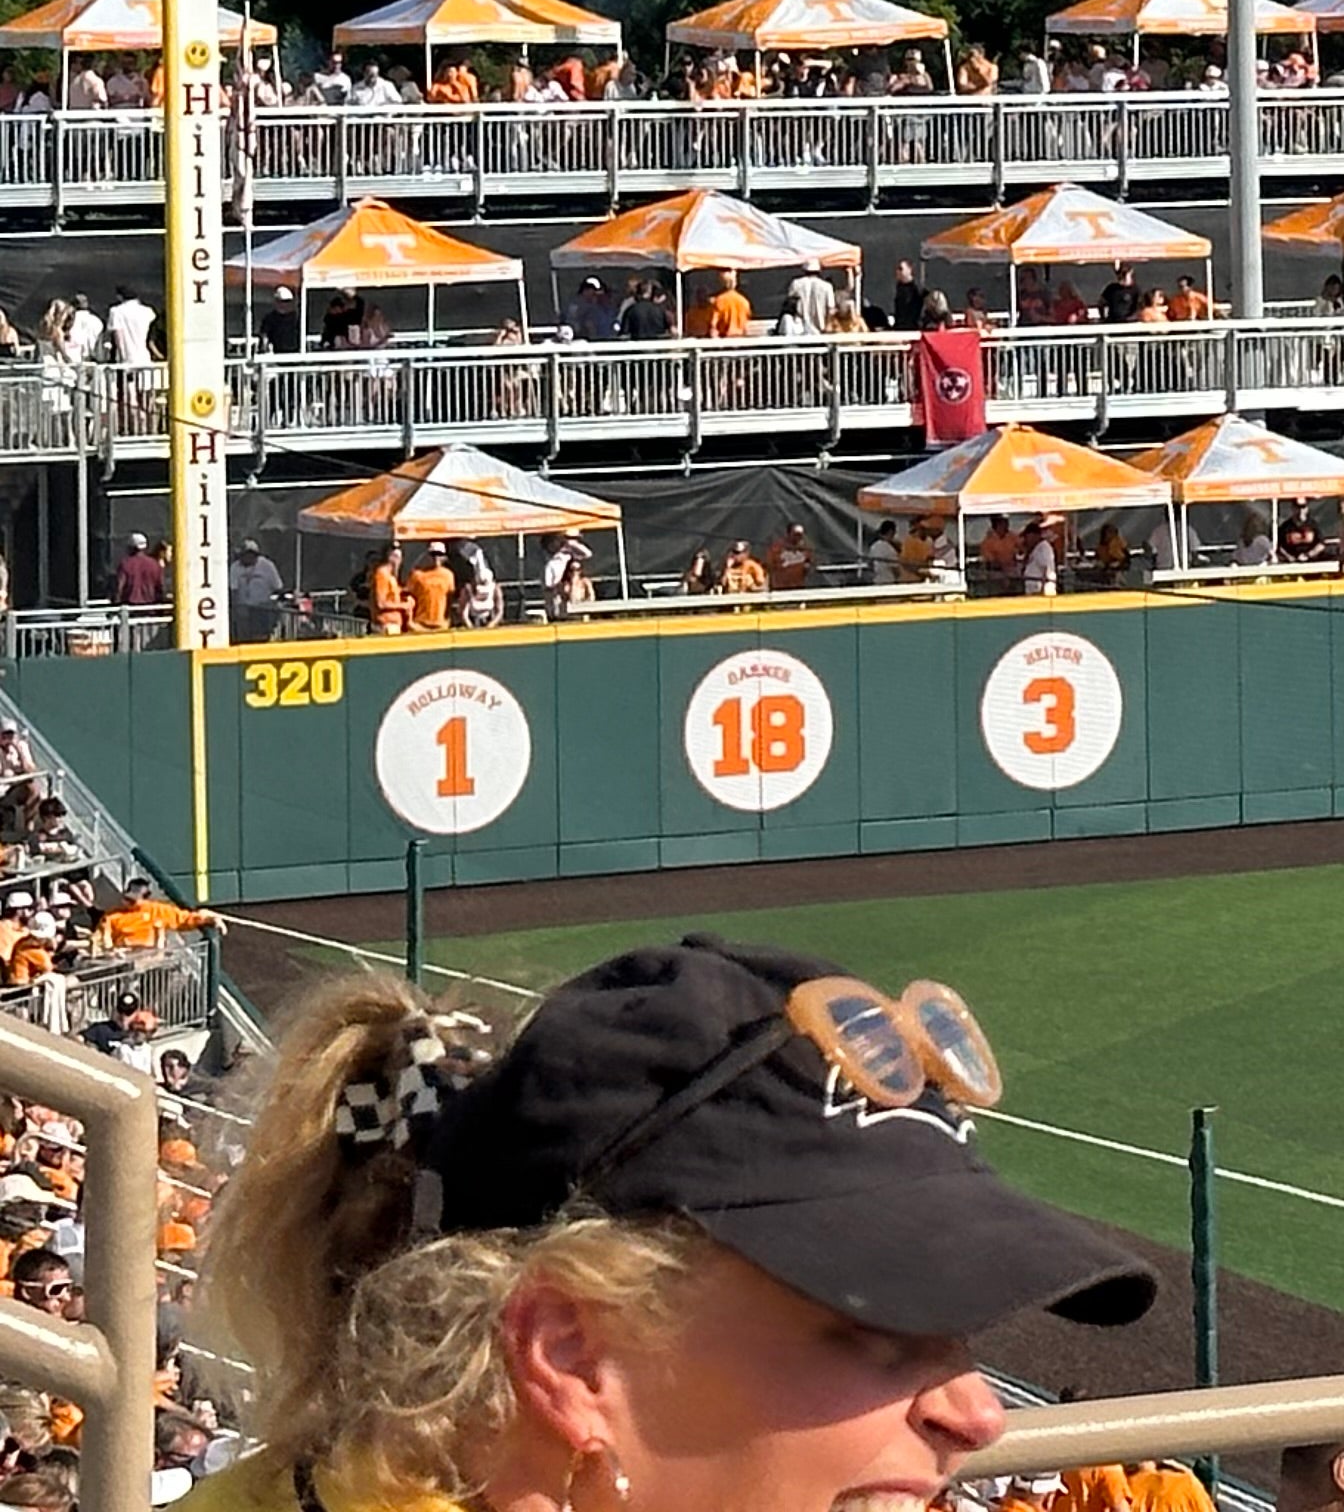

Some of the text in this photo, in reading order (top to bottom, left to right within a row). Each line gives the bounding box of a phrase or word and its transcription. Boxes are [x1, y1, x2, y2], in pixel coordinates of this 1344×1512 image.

[181, 83, 213, 304] Hiller
[188, 432, 218, 649] Hiller
[245, 659, 344, 708] 320
[1022, 676, 1076, 754] 3
[435, 716, 476, 798] 1
[713, 694, 805, 777] 18
